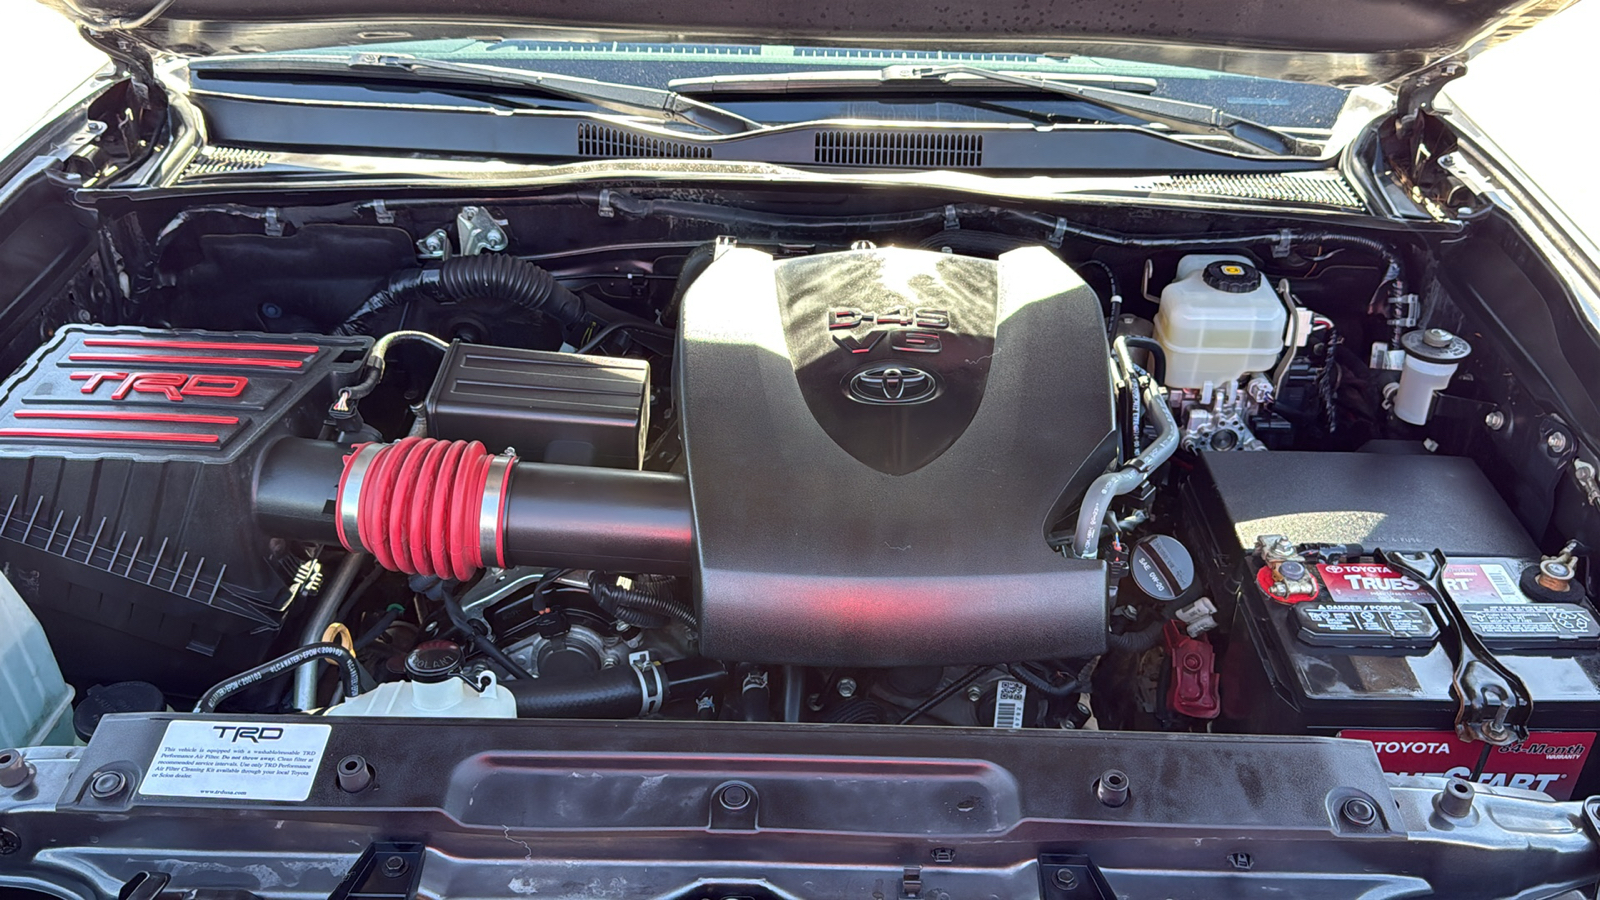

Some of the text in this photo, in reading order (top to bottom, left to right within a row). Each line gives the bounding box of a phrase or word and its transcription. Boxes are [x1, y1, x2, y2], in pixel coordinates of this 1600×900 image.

[832, 330, 942, 353] V6
[69, 371, 249, 401] TRD
[1138, 557, 1152, 572] SAE
[1148, 571, 1165, 592] 0W-20
[1343, 565, 1392, 574] TOYOTA
[1344, 574, 1473, 591] TRUESRT
[213, 725, 284, 743] TRD
[1374, 741, 1450, 754] TOYOTA
